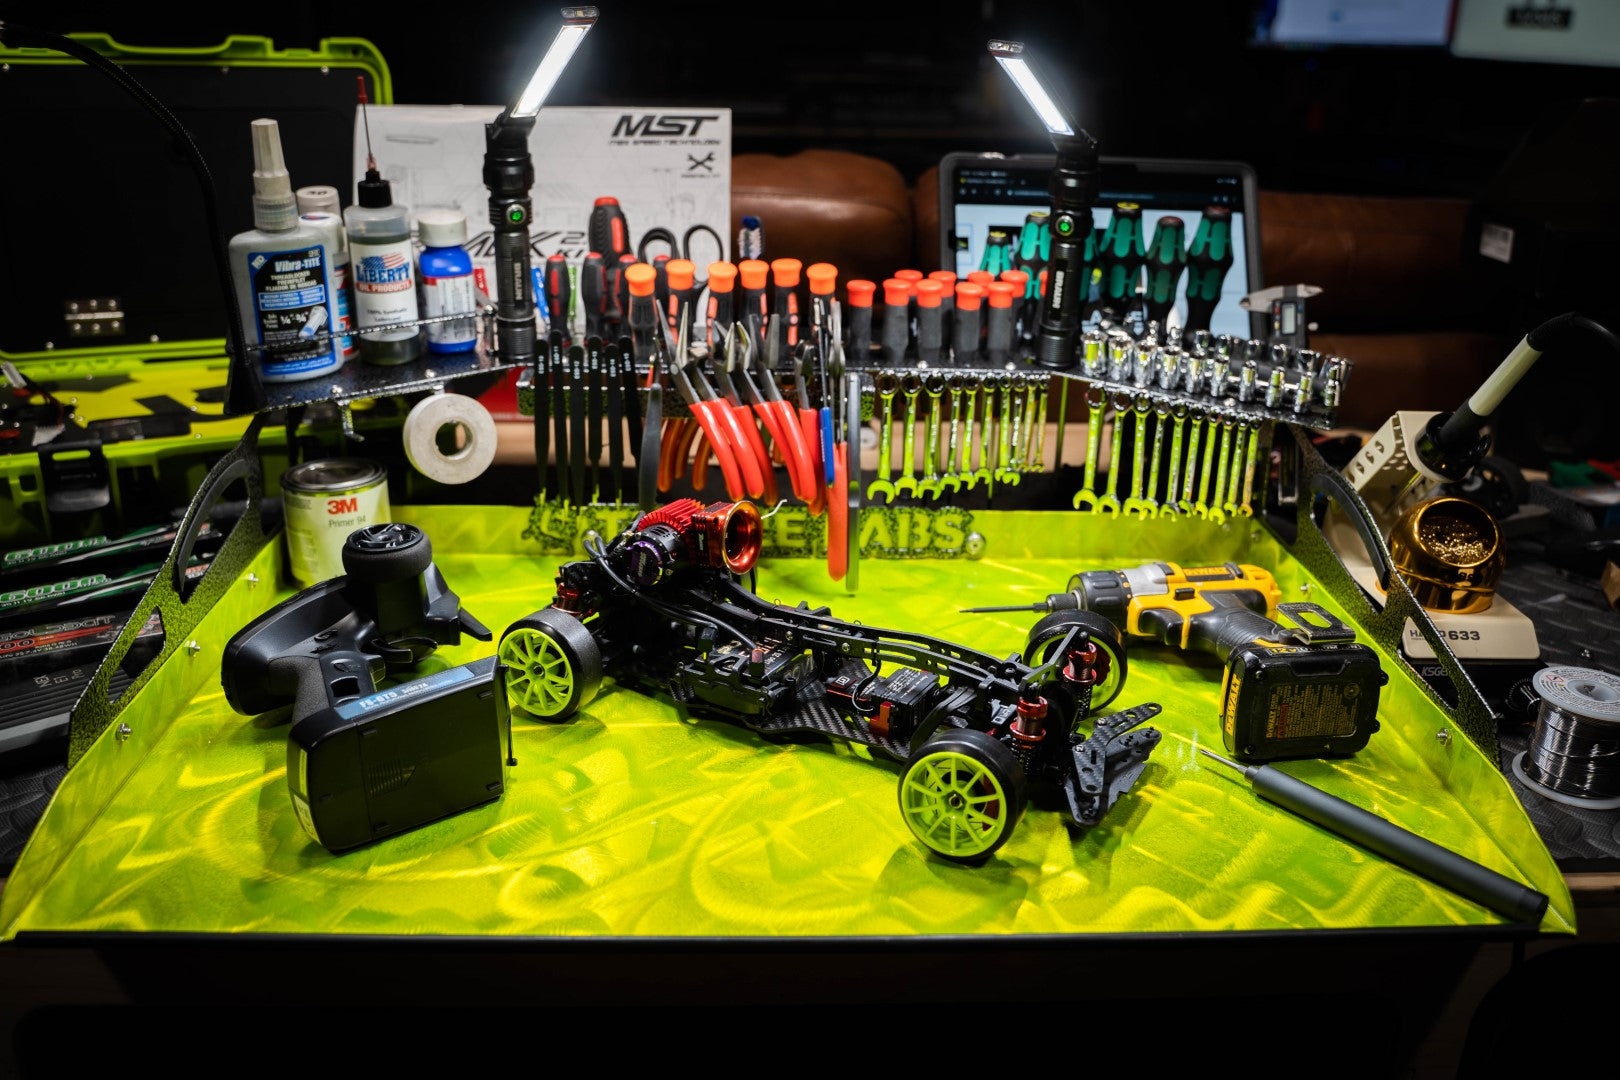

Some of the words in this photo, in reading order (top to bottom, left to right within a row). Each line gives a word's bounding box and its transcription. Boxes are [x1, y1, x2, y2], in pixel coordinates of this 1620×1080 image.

[611, 115, 719, 136] MST
[355, 262, 410, 283] LIBERTY
[327, 497, 358, 515] 3M
[328, 518, 354, 527] Primer
[826, 510, 966, 549] ABS
[1449, 631, 1480, 640] 633
